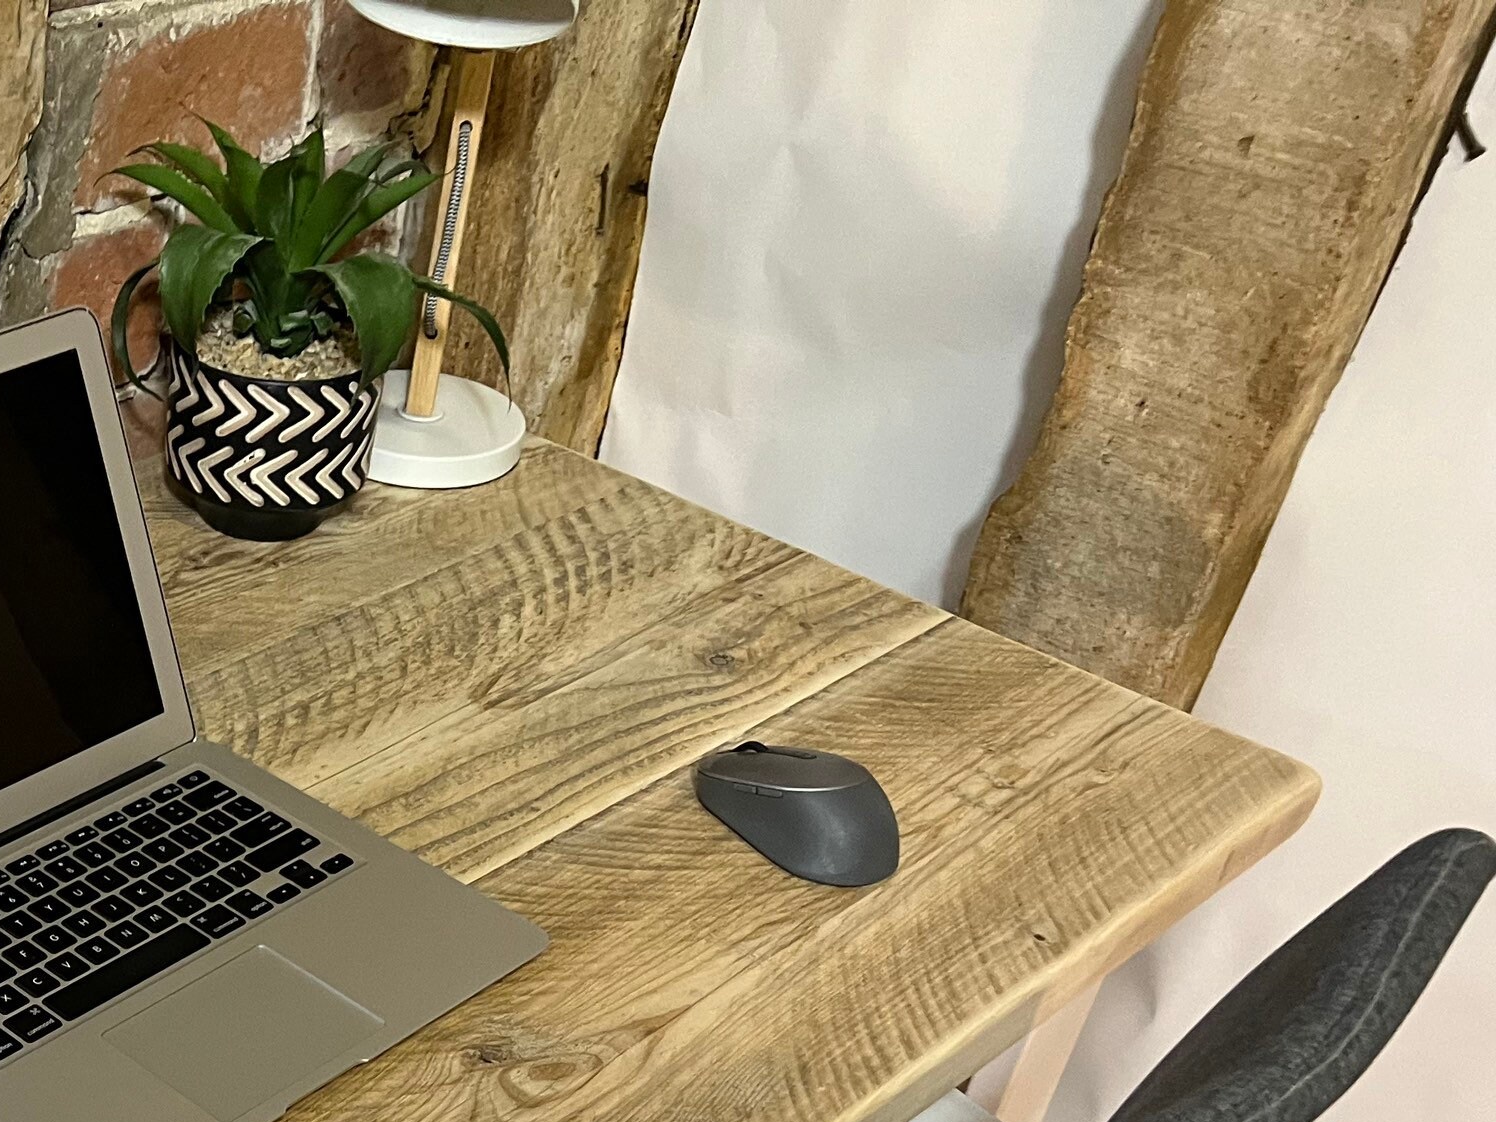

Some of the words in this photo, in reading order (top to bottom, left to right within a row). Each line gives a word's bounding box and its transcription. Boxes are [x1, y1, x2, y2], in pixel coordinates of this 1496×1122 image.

[14, 919, 24, 927] T
[44, 904, 55, 912] Y
[72, 888, 84, 897] U
[19, 949, 28, 958] F
[49, 934, 60, 942] G
[78, 918, 90, 927] H
[136, 888, 147, 896] K
[0, 993, 12, 1003] X
[32, 977, 43, 985] C
[61, 960, 71, 969] V
[91, 945, 103, 953] B
[149, 913, 162, 923] M
[27, 1017, 55, 1036] command
